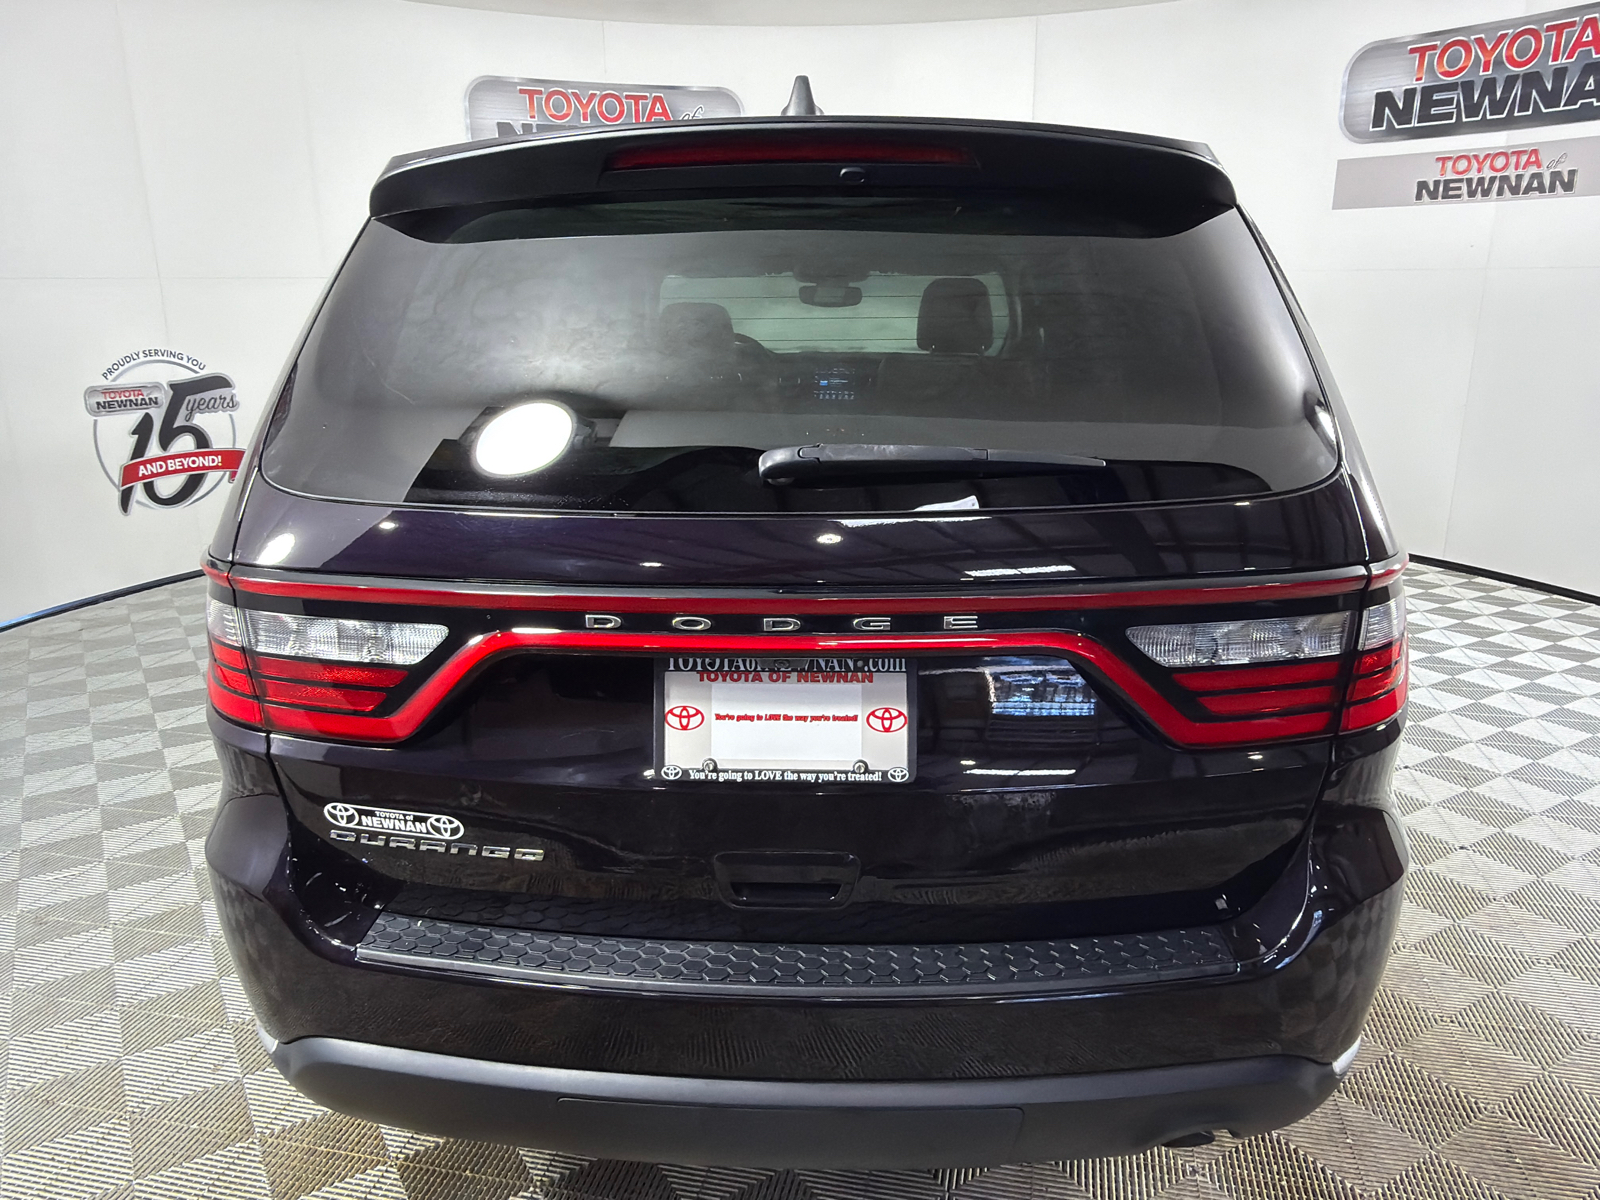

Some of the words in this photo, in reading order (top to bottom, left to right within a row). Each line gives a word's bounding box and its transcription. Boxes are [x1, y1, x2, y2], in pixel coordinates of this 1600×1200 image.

[1408, 14, 1600, 83] TOYOTA
[517, 86, 673, 124] TOYOTA
[1369, 61, 1600, 131] NEWNA
[1435, 148, 1543, 177] TOYOTA
[1546, 153, 1568, 170] of
[1414, 168, 1577, 202] NEWNAN
[102, 351, 140, 381] PROUDLY
[142, 348, 184, 361] SERVING
[186, 355, 206, 371] YOU
[95, 396, 159, 410] NEWNAN
[101, 389, 144, 399] TOYOTA
[185, 393, 237, 422] years
[138, 462, 166, 477] AND
[168, 455, 222, 471] BEYOND!
[585, 614, 978, 631] DODGE
[696, 671, 763, 683] TOYOTA
[768, 672, 792, 683] OF
[796, 672, 874, 684] NEWNAN
[688, 769, 717, 780] You're
[718, 770, 742, 782] going
[743, 771, 753, 780] to
[754, 771, 782, 780] LOVE
[784, 770, 798, 780] the
[799, 772, 817, 782] way
[818, 771, 846, 782] you're
[847, 771, 882, 782] treated!
[361, 815, 427, 833] NEWNAN
[375, 811, 405, 820] TOYOTA
[330, 829, 545, 861] DURANGO
